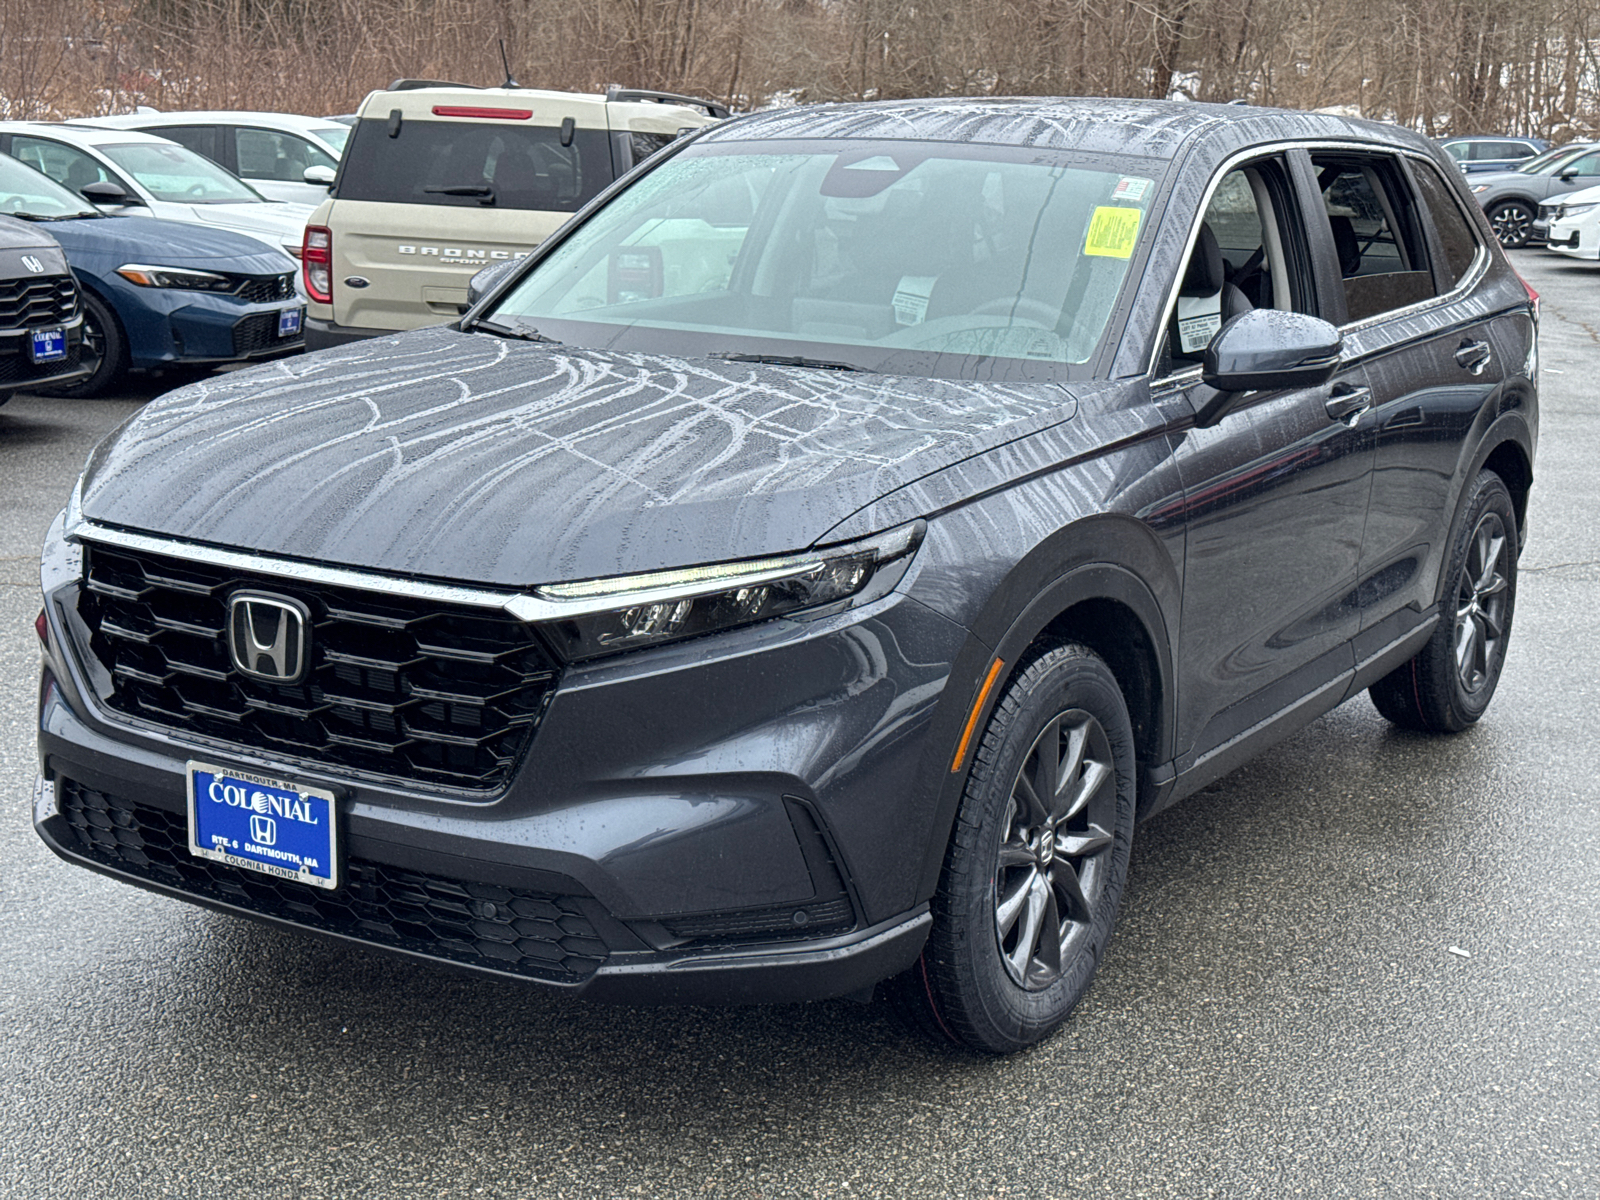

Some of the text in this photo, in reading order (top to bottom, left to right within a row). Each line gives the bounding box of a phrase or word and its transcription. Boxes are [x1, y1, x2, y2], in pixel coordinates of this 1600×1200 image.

[399, 245, 530, 259] BRONCO
[283, 782, 298, 791] MA
[208, 782, 318, 825] COLONIAL
[211, 834, 319, 868] RTE. 6 DARTMOUTH, MA
[224, 855, 299, 880] COLONIAL HONDA
